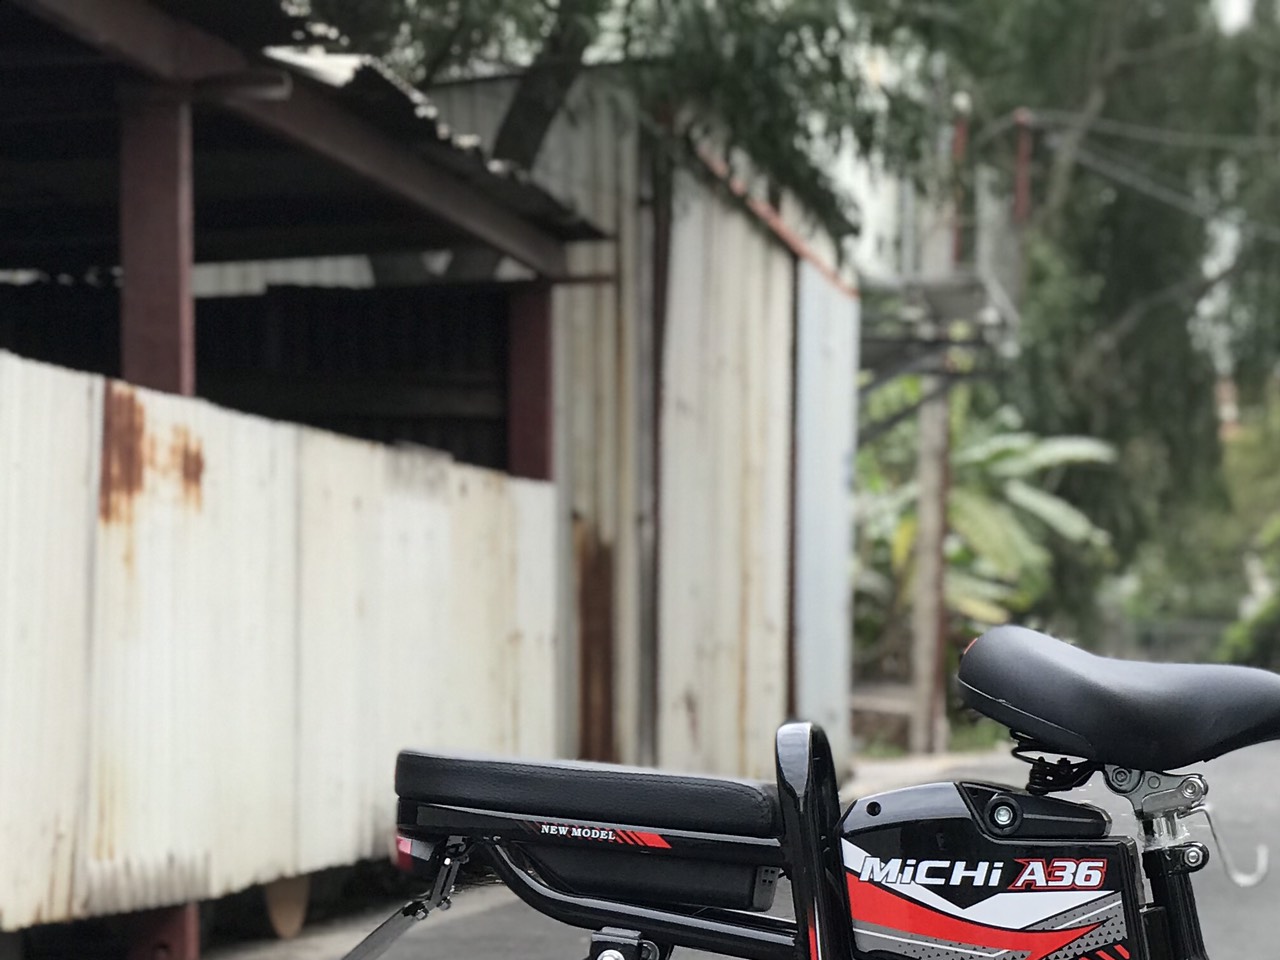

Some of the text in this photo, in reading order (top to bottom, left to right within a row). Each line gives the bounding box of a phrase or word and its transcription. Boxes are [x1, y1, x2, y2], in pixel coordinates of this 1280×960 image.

[541, 824, 616, 840] NEW MODEL
[1008, 857, 1109, 890] A36
